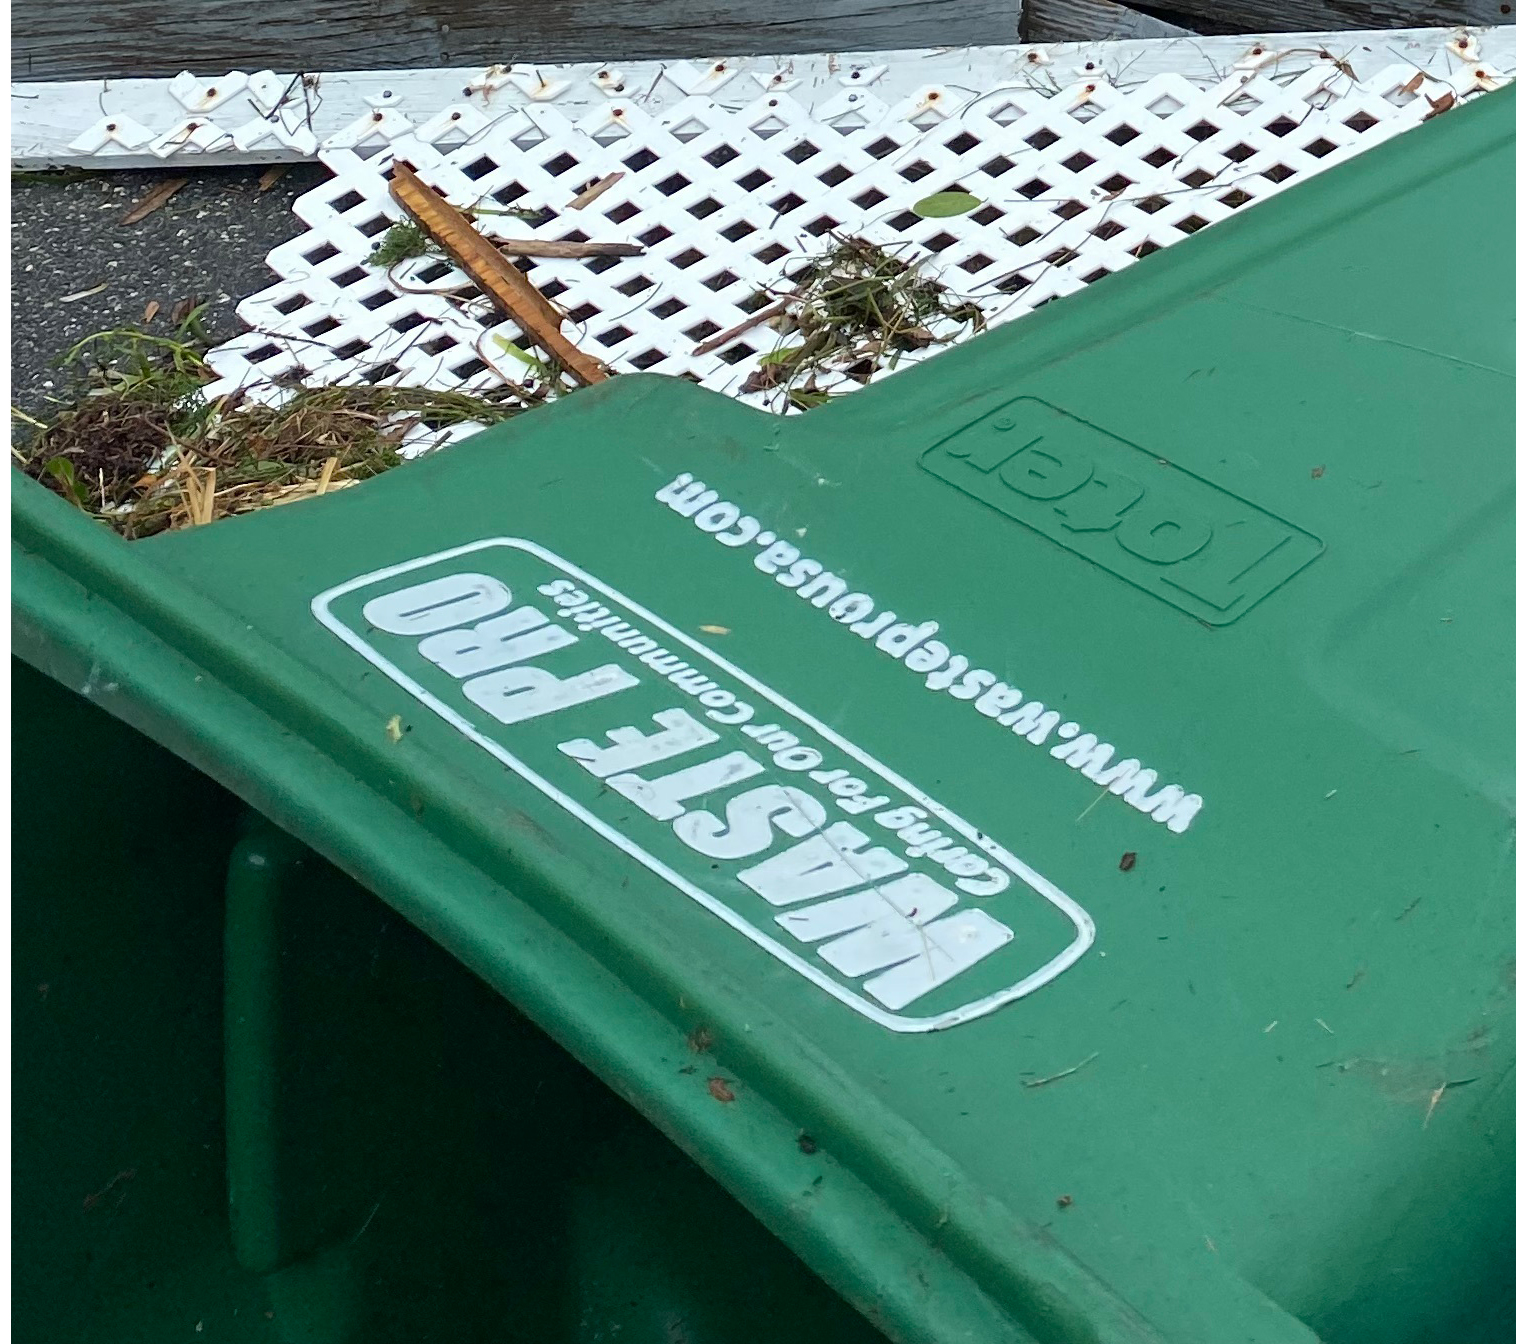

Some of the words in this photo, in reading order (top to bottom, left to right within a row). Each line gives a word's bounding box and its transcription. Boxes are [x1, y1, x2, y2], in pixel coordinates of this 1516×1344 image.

[361, 571, 641, 725] PRO
[536, 579, 755, 725] Communities
[654, 472, 1204, 834] www.wasteprousa.com
[739, 723, 823, 772] Our
[807, 768, 891, 815] For
[555, 706, 1015, 1011] WASTE
[873, 805, 1011, 897] Caring
